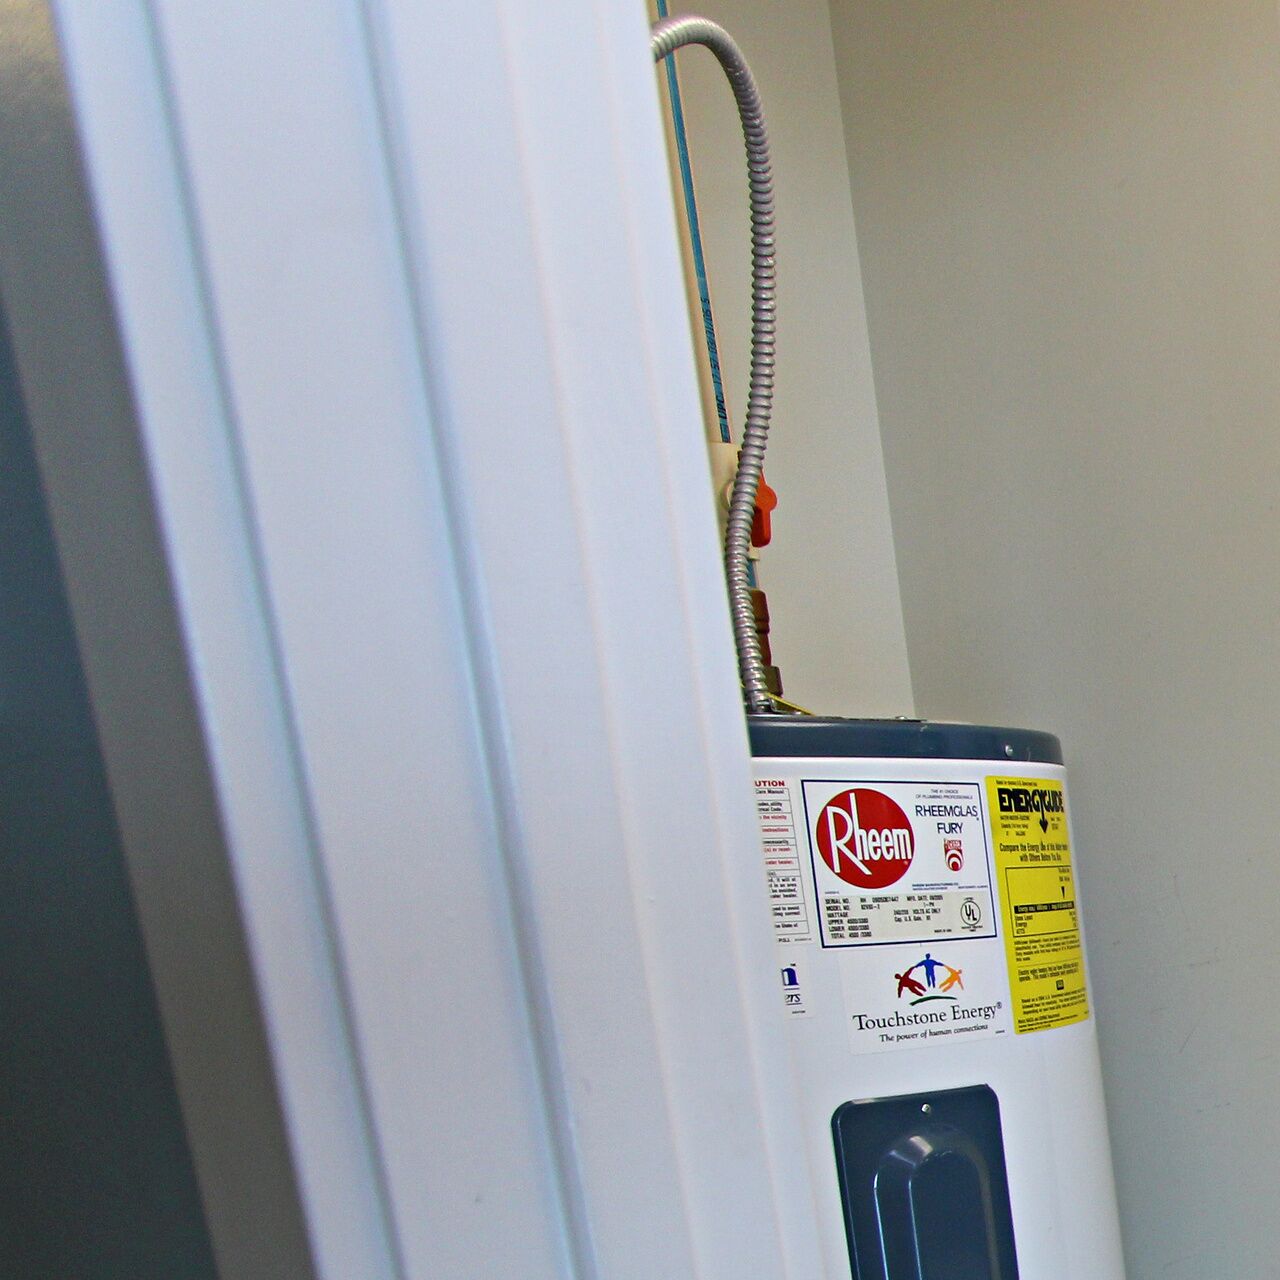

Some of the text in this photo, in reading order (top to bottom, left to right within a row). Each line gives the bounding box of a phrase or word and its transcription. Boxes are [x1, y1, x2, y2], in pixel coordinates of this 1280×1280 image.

[754, 780, 785, 788] UTION
[916, 805, 978, 817] RHEEMGLAS
[826, 792, 913, 876] Rheem
[937, 822, 963, 834] FURY
[965, 905, 977, 921] UL
[852, 1011, 947, 1030] Touchstone
[880, 1024, 988, 1042] The power of human connections
